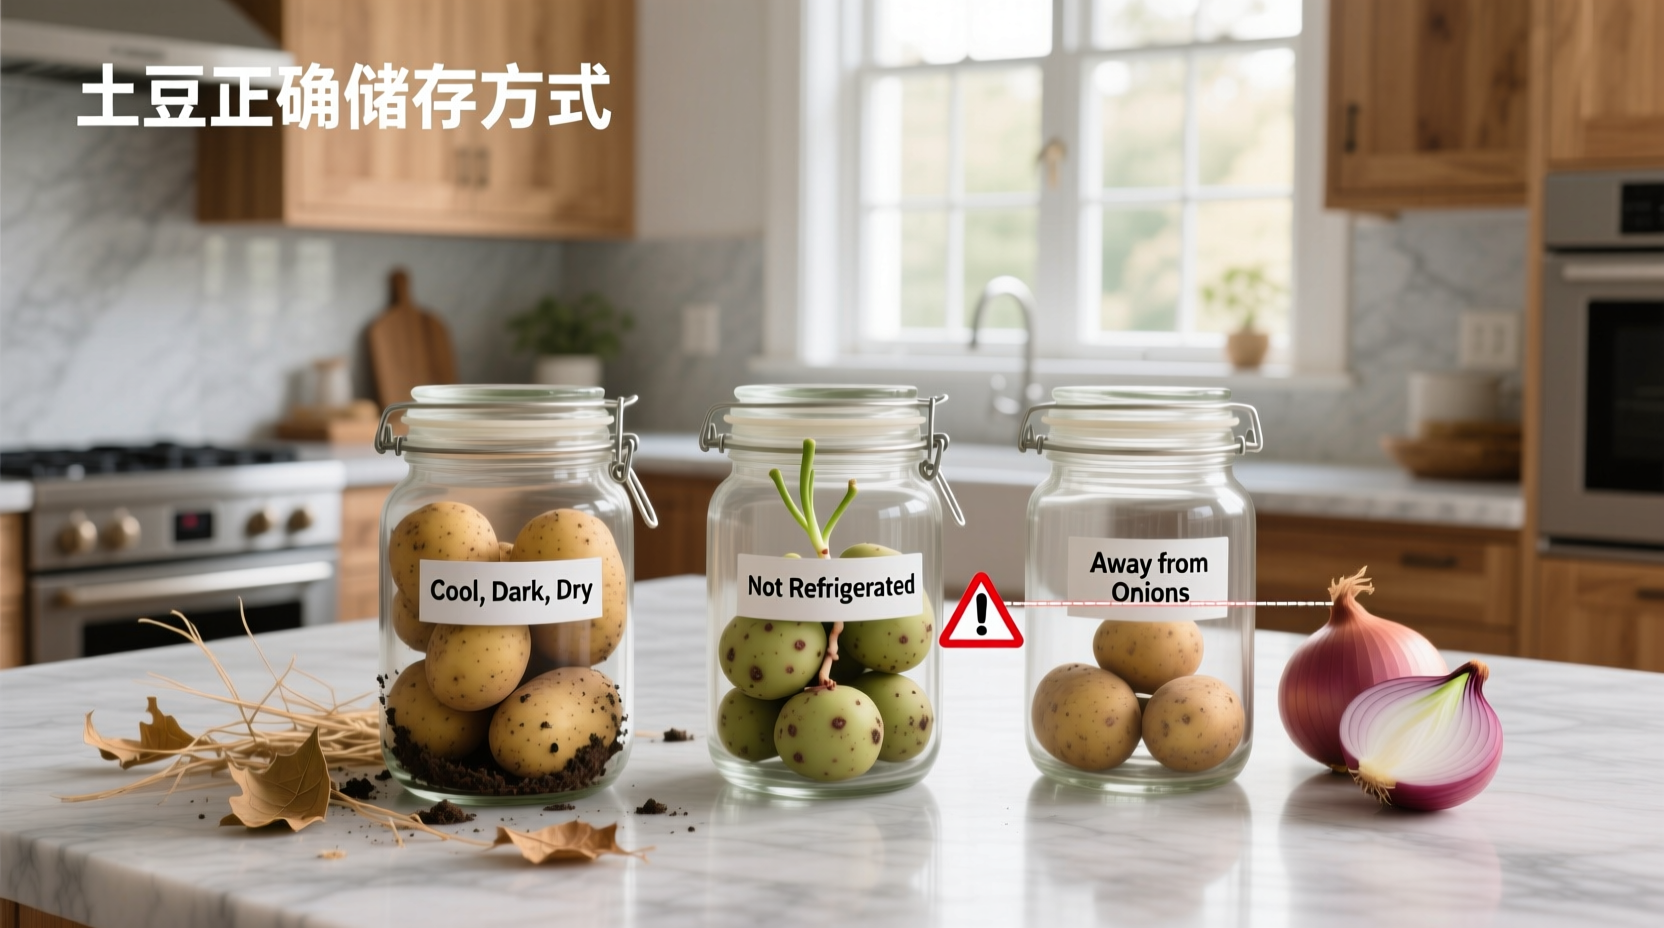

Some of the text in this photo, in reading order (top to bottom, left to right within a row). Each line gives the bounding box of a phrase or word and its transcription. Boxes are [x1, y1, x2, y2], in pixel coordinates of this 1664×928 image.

[1089, 551, 1208, 580] Away from
[430, 578, 593, 606] Cool, Dark, Dry
[748, 573, 916, 604] Not Refrigerated
[1111, 580, 1190, 603] Onions
